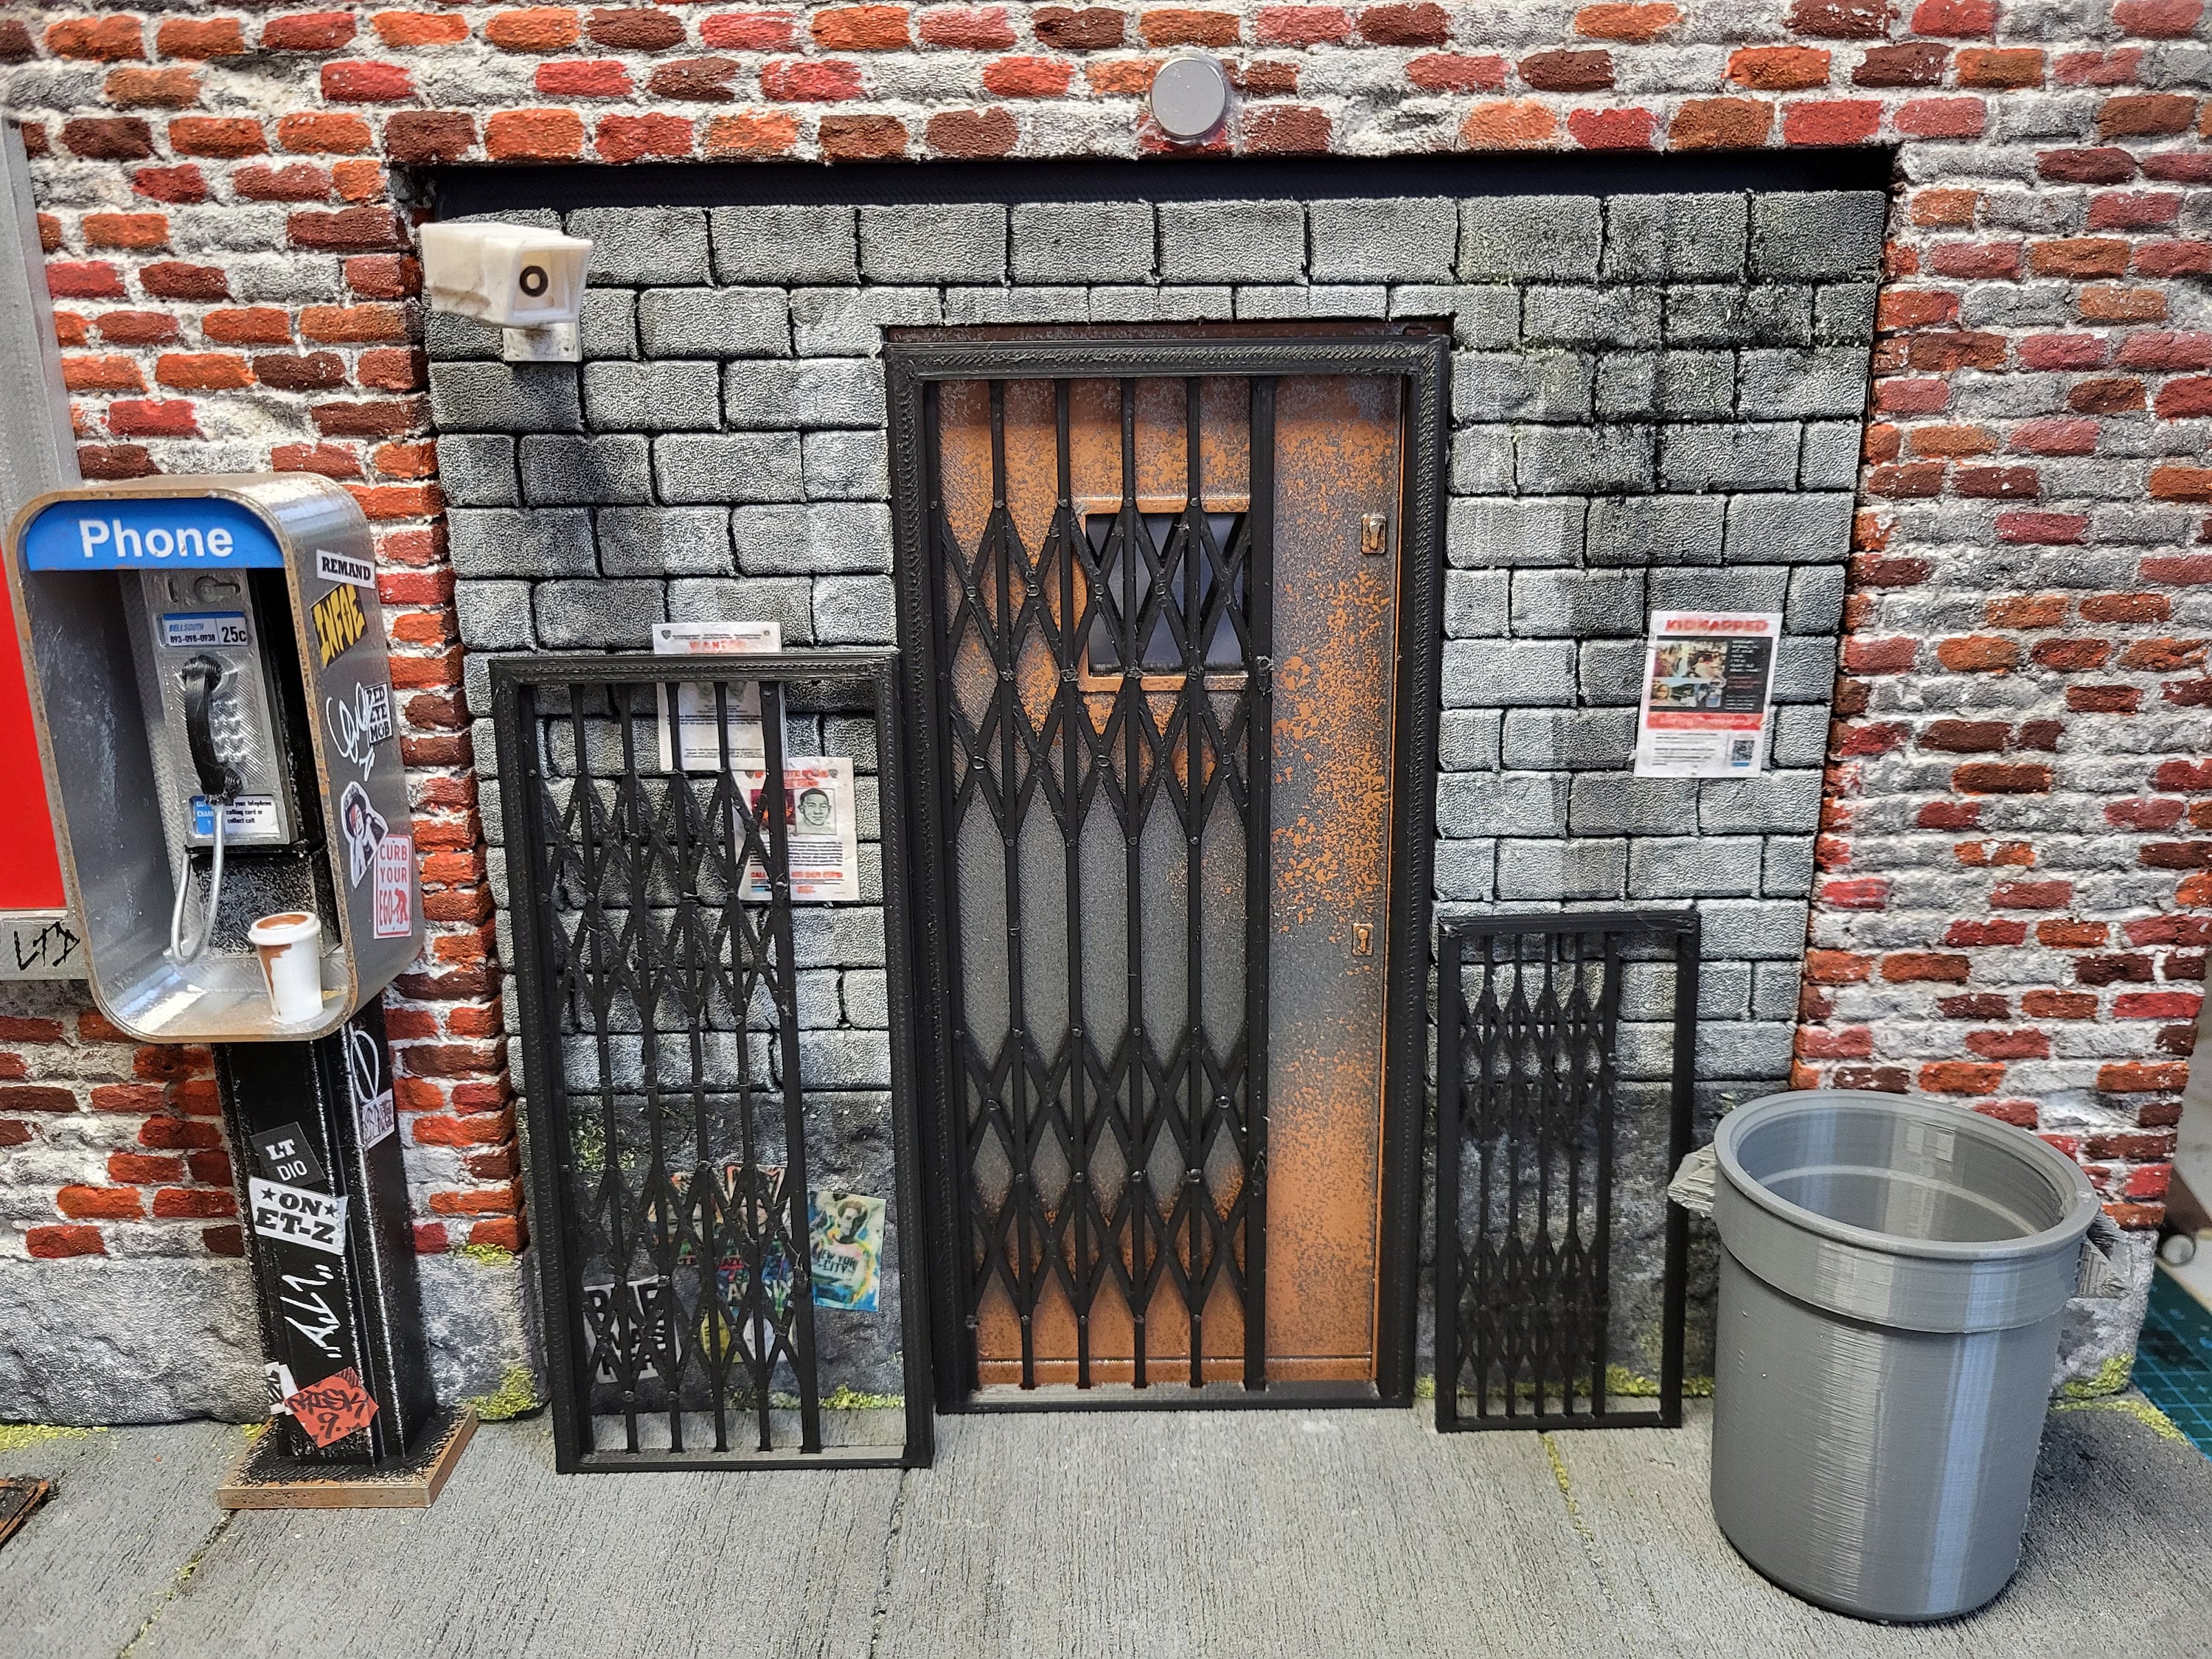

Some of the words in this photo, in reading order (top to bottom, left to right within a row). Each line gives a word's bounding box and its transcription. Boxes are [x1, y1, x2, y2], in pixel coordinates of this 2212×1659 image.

[80, 519, 234, 558] Phone
[321, 557, 371, 581] REMAND
[169, 623, 204, 632] BELLSOUTH
[221, 626, 247, 643] 25c
[370, 720, 390, 741] MOB
[380, 844, 407, 861] CURB
[380, 866, 407, 883] YOUR
[379, 888, 393, 926] EGO
[265, 1138, 296, 1160] LT
[276, 1160, 307, 1180] DIO
[279, 1193, 323, 1217] ON
[255, 1206, 335, 1245] ET-Z
